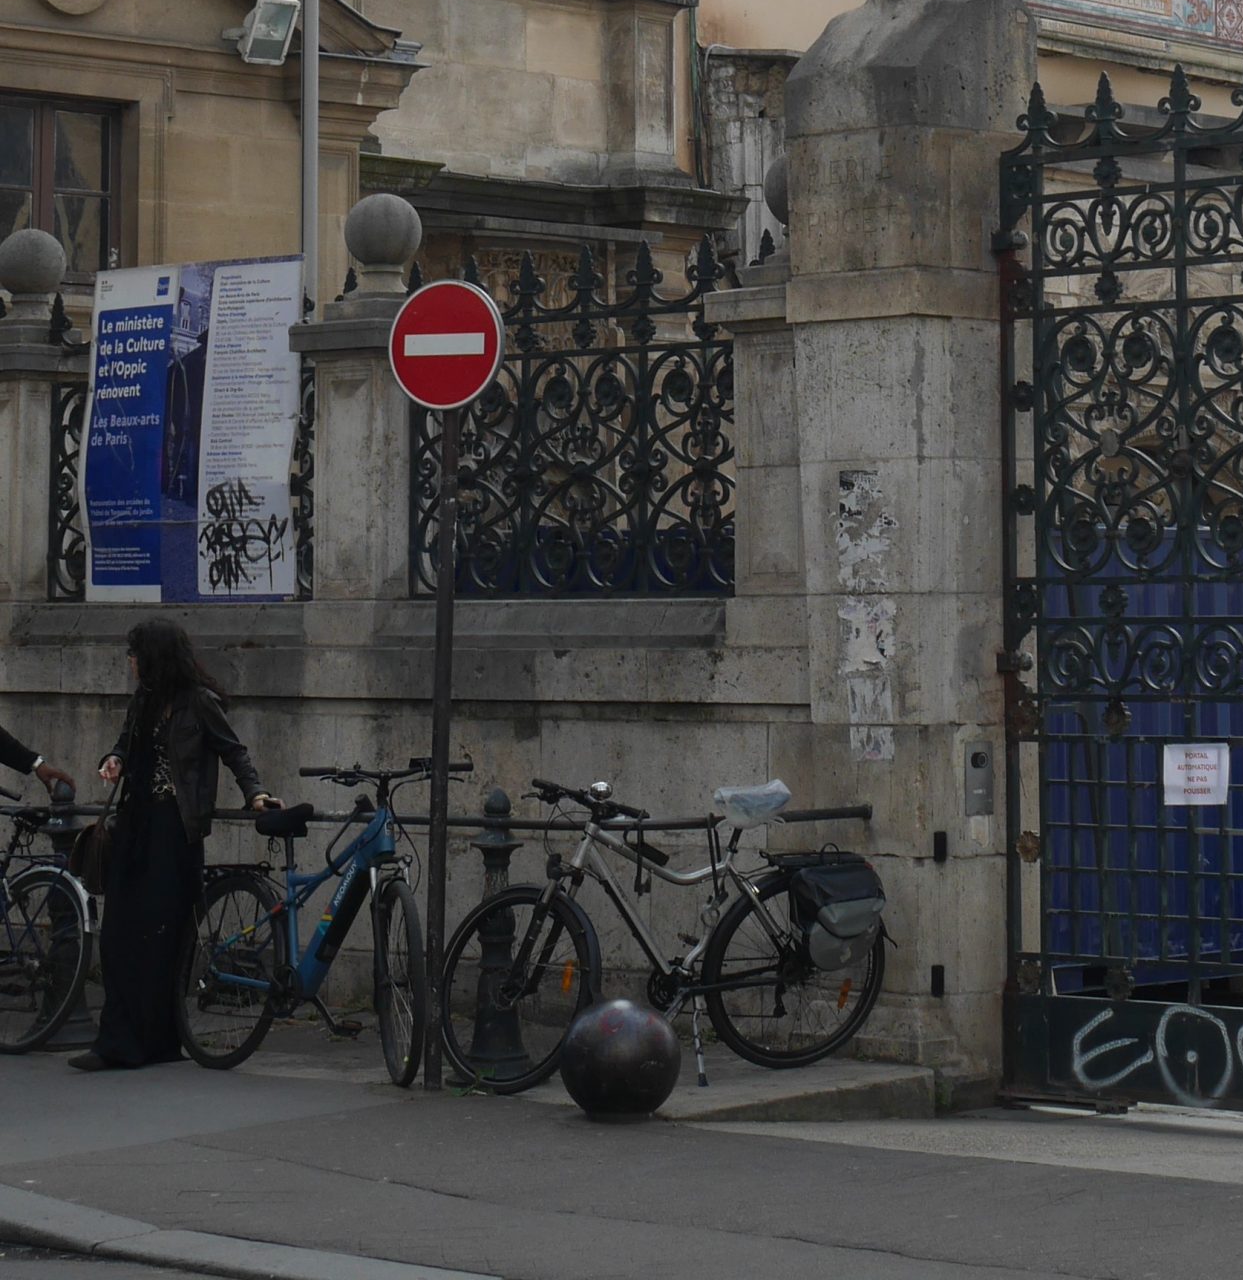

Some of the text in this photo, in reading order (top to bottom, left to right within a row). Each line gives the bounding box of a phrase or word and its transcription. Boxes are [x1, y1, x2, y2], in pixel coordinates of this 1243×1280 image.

[807, 153, 894, 193] PIERRE
[101, 314, 164, 333] Le ministère
[100, 338, 166, 355] de la Culture
[98, 358, 148, 380] et l'Oppic
[96, 383, 141, 400] rénovent
[93, 413, 160, 429] Les Beaux-arts
[91, 432, 128, 447] de Paris
[1184, 752, 1209, 760] PORTAIL
[1177, 763, 1217, 772] AUTOMATIQUE
[1196, 775, 1208, 783] PAS
[1183, 787, 1212, 795] POUSSER
